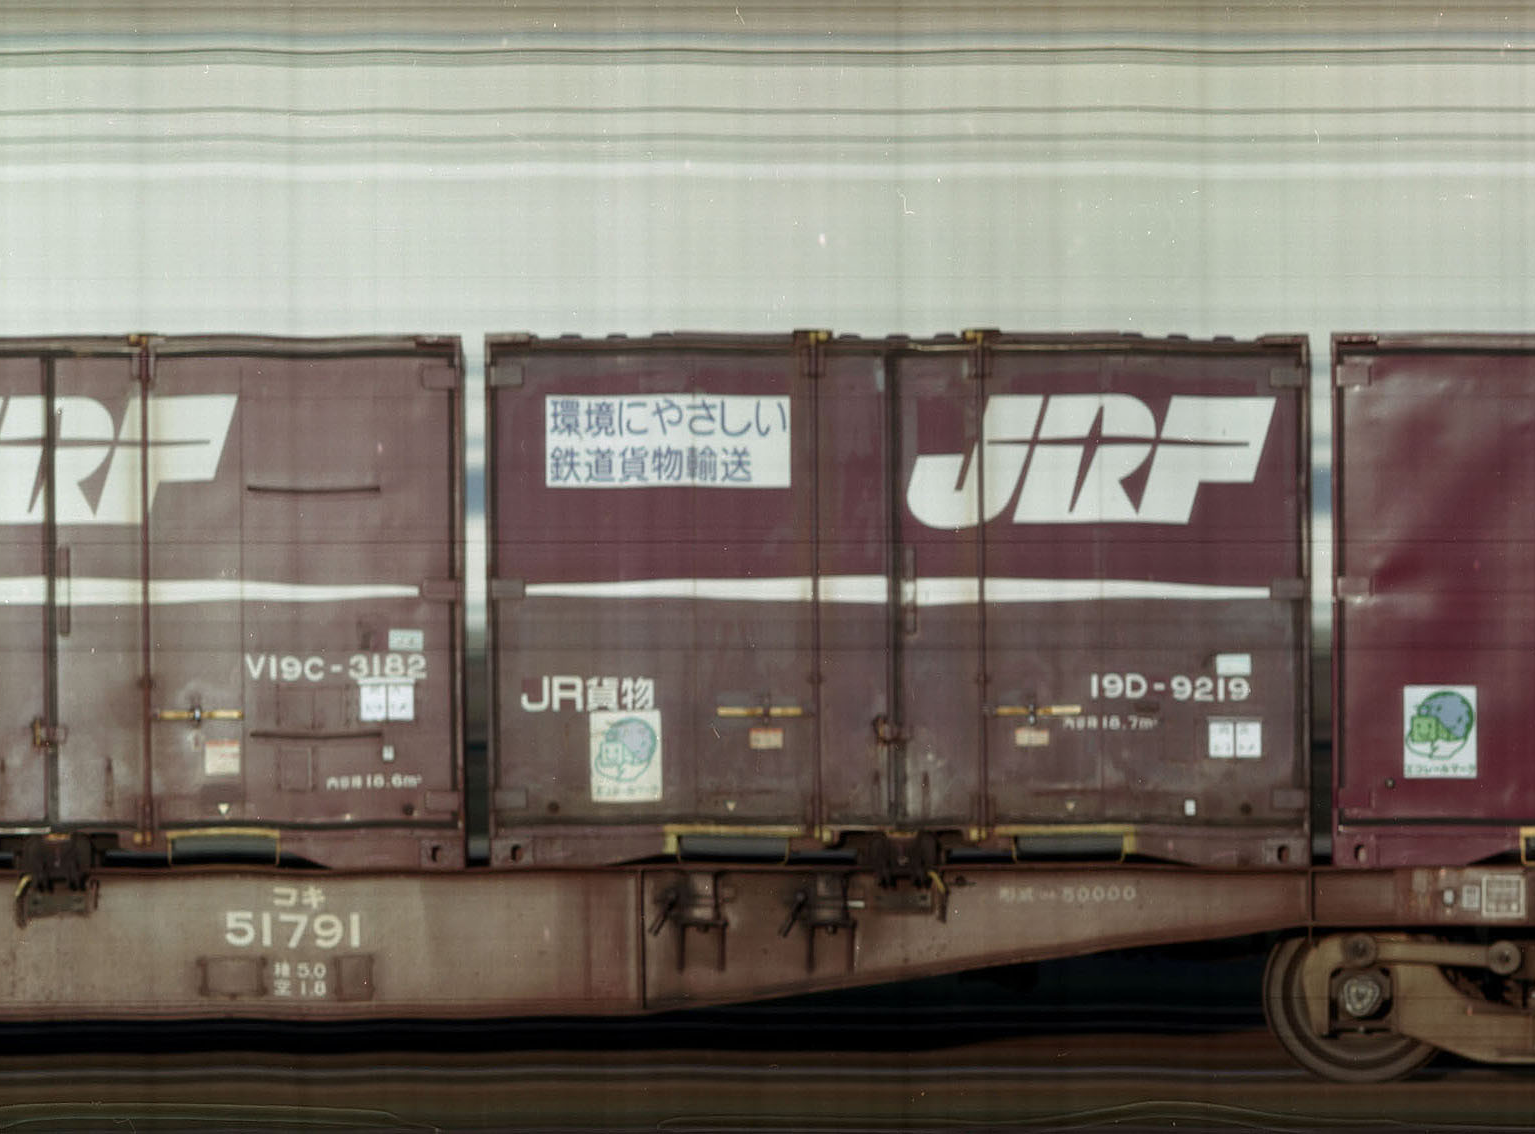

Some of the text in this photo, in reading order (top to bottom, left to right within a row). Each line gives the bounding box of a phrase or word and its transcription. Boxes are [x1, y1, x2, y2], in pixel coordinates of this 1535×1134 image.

[549, 399, 787, 438] 環境にやさしい
[549, 446, 752, 484] 鉄道貨物輸送
[906, 394, 1277, 530] JRF
[244, 653, 426, 681] V19C-3182
[520, 676, 656, 712] JR貨物
[1090, 672, 1251, 702] 19D-9219
[272, 886, 326, 909] コキ
[225, 911, 361, 949] 51791
